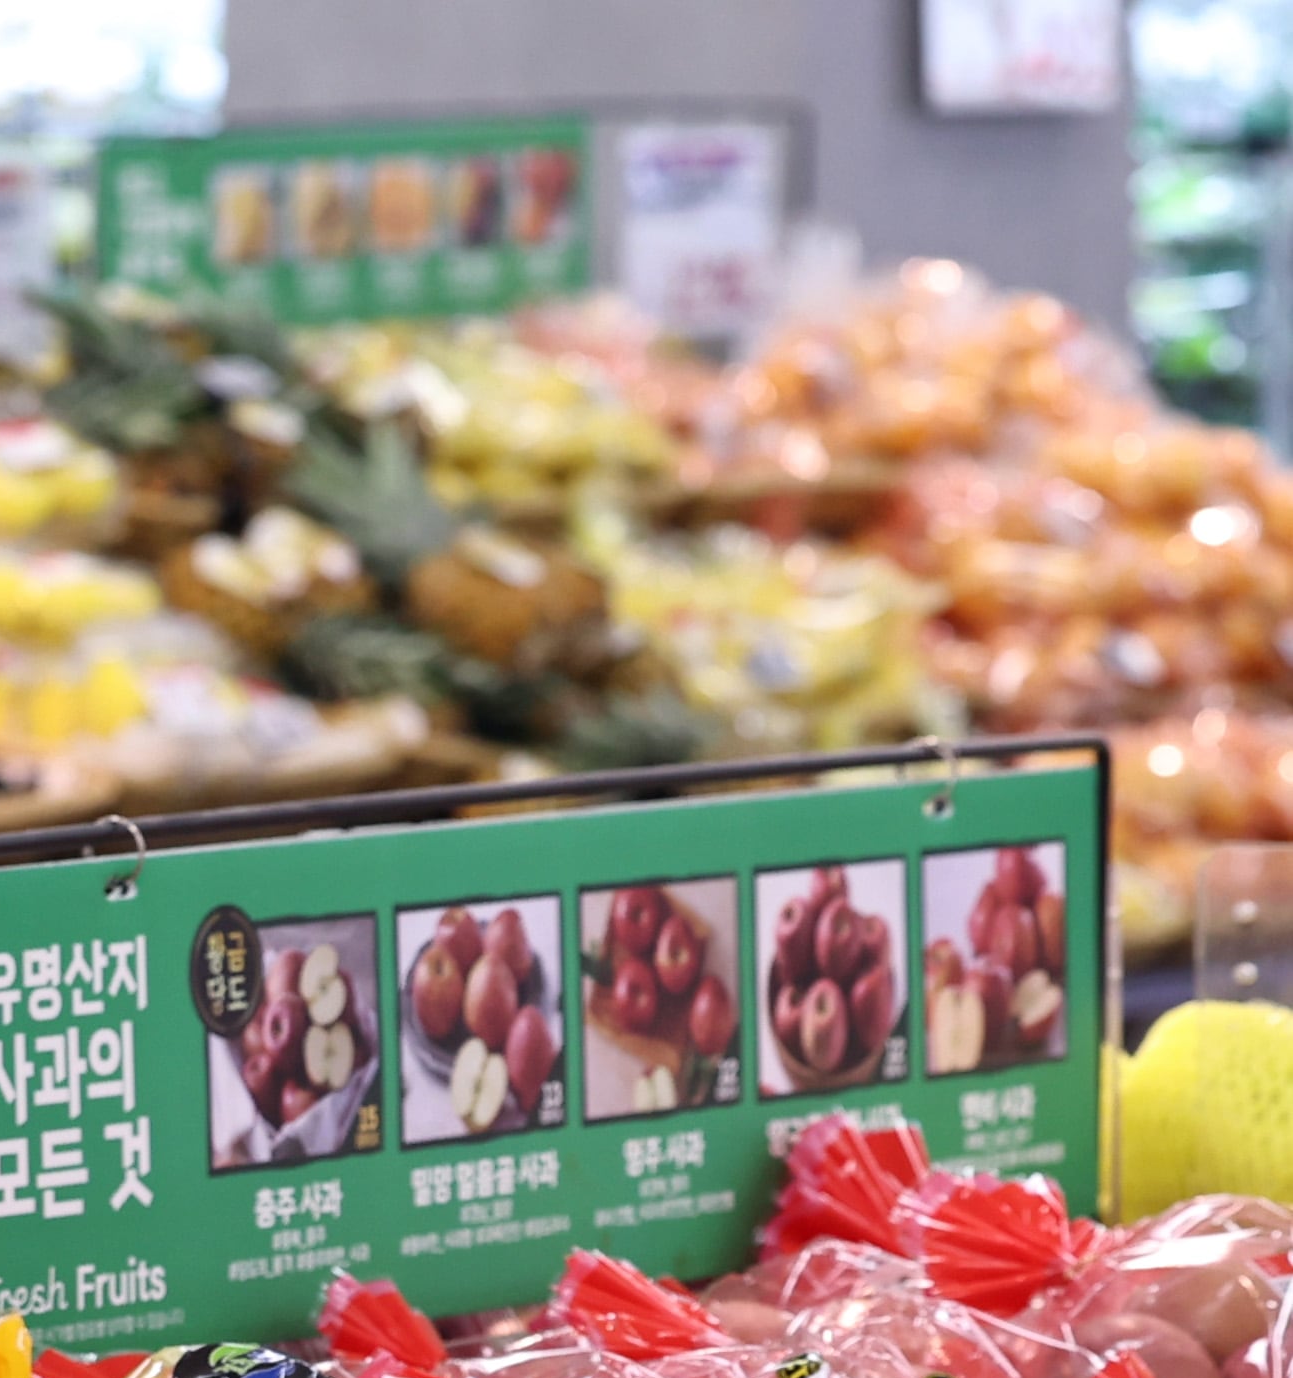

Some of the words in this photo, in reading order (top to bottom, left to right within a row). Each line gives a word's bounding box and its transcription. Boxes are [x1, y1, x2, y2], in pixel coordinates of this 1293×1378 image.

[103, 1116, 154, 1211] 것
[519, 1149, 559, 1191] 사과
[666, 1130, 705, 1168] 사과
[299, 1178, 343, 1221] 사과
[76, 1256, 167, 1312] Fruits
